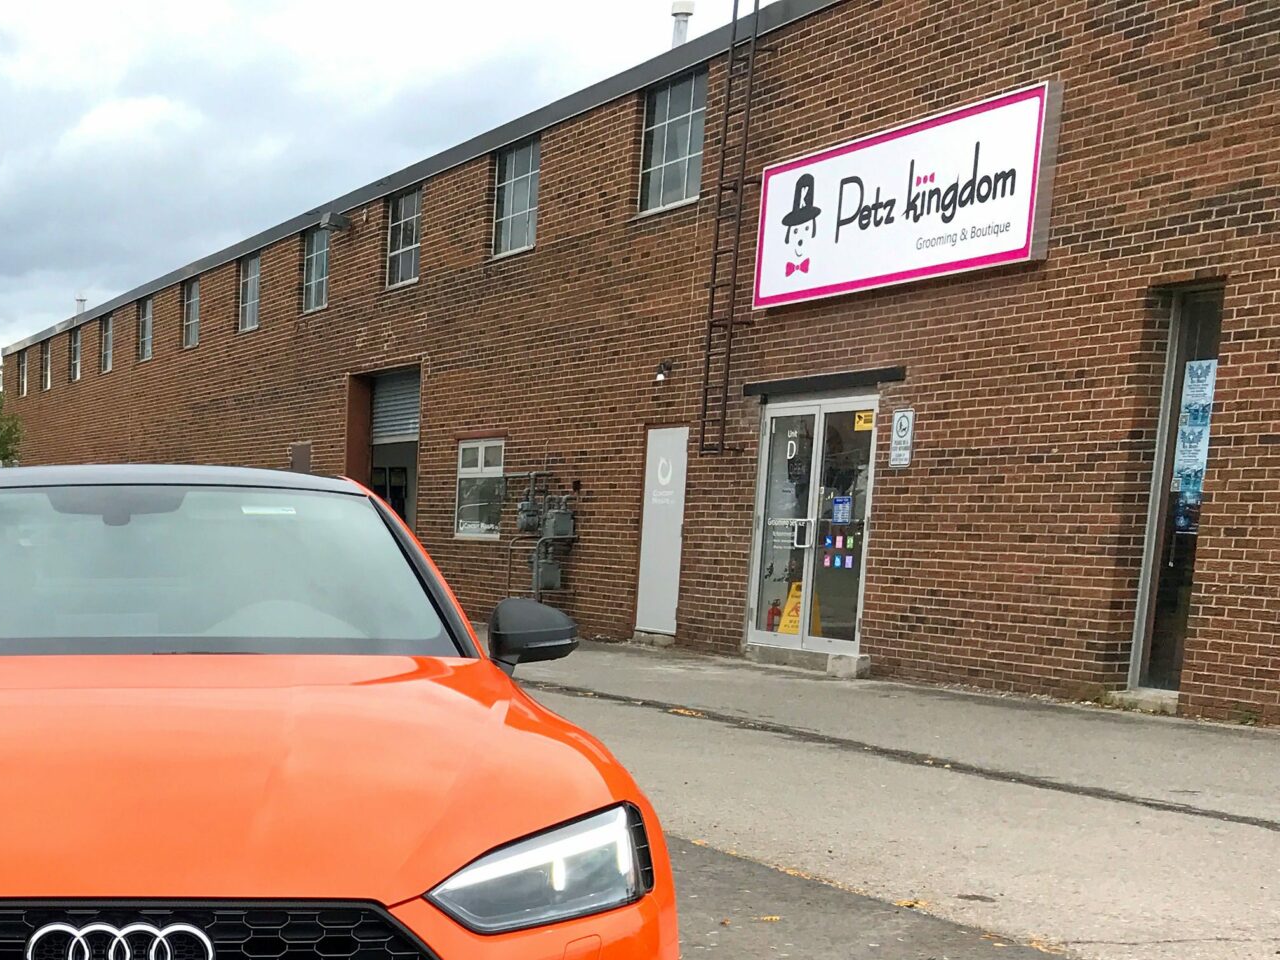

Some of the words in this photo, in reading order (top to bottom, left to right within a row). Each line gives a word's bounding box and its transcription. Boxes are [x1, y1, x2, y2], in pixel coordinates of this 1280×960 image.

[834, 175, 897, 243] Petz
[901, 141, 1017, 224] kingdom
[916, 232, 958, 250] Grooming
[960, 227, 968, 241] &
[970, 221, 1012, 239] Boutique
[786, 440, 797, 460] D
